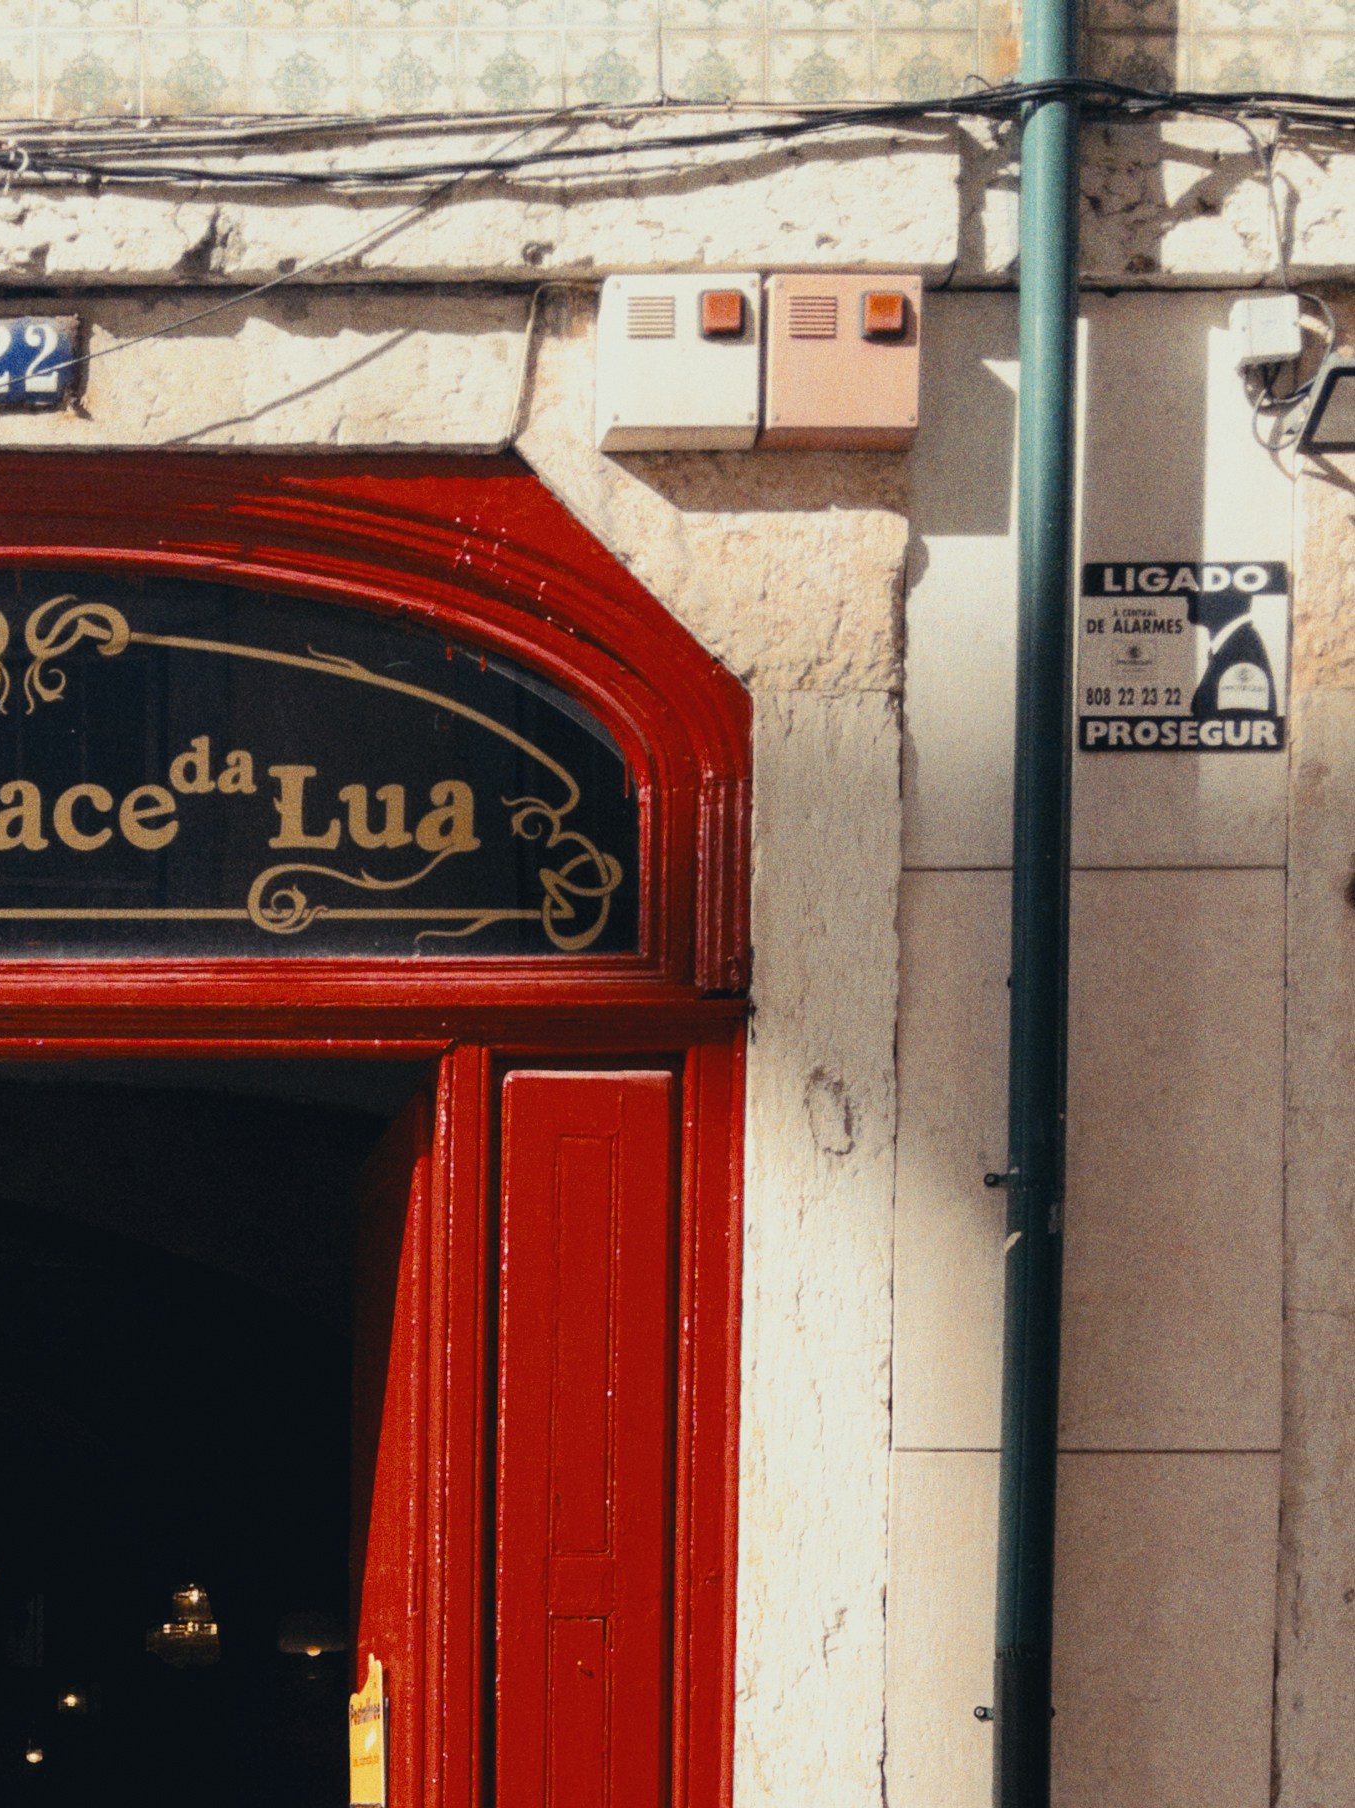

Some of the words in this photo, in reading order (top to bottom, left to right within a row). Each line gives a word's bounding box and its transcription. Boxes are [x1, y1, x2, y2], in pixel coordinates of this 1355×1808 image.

[1102, 565, 1269, 593] LIGADO
[1086, 619, 1105, 635] DE
[1113, 618, 1184, 635] ALARMES
[1086, 687, 1111, 706] 808
[1118, 687, 1134, 706] 22
[1142, 687, 1158, 706] 23
[1165, 687, 1182, 706] 22
[1085, 720, 1278, 746] PROSEGUR
[169, 735, 257, 794] da
[267, 764, 482, 852] Lua
